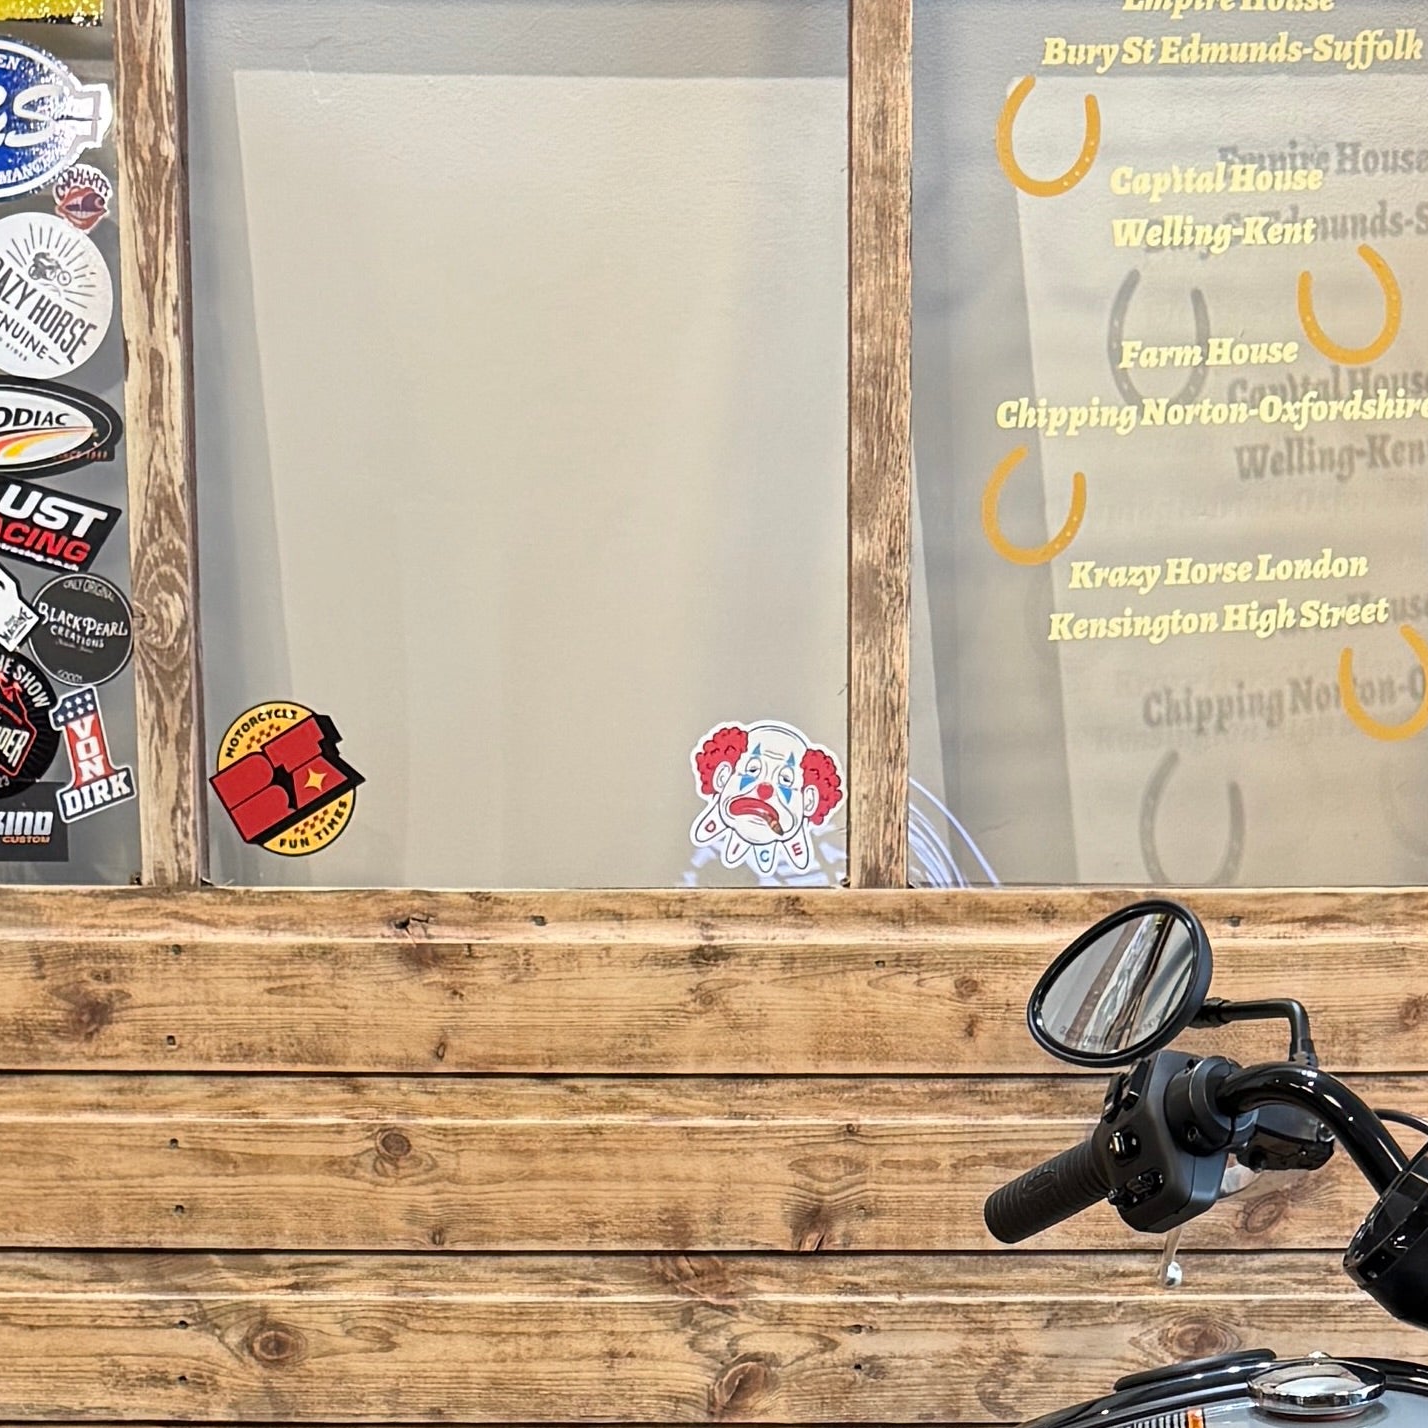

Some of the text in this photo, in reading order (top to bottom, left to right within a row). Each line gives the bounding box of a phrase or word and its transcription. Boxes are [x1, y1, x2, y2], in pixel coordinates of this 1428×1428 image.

[1042, 29, 1424, 74] Bury St Edmunds-Suffolk
[1110, 162, 1324, 202] Capital House
[1112, 216, 1317, 254] Welling-Kent
[27, 294, 98, 365] HORSE
[1119, 337, 1299, 369] Farm House
[997, 397, 1137, 440] Chipping
[1069, 548, 1368, 595] Krazy Horse London
[1048, 598, 1390, 644] Kensington High Street
[12, 664, 51, 708] SHOW
[71, 714, 109, 782] VON
[225, 708, 298, 759] MOTORCYCLE
[64, 772, 131, 818] DIRK
[2, 835, 51, 844] CUSTOM
[279, 800, 348, 848] FUN TIMES
